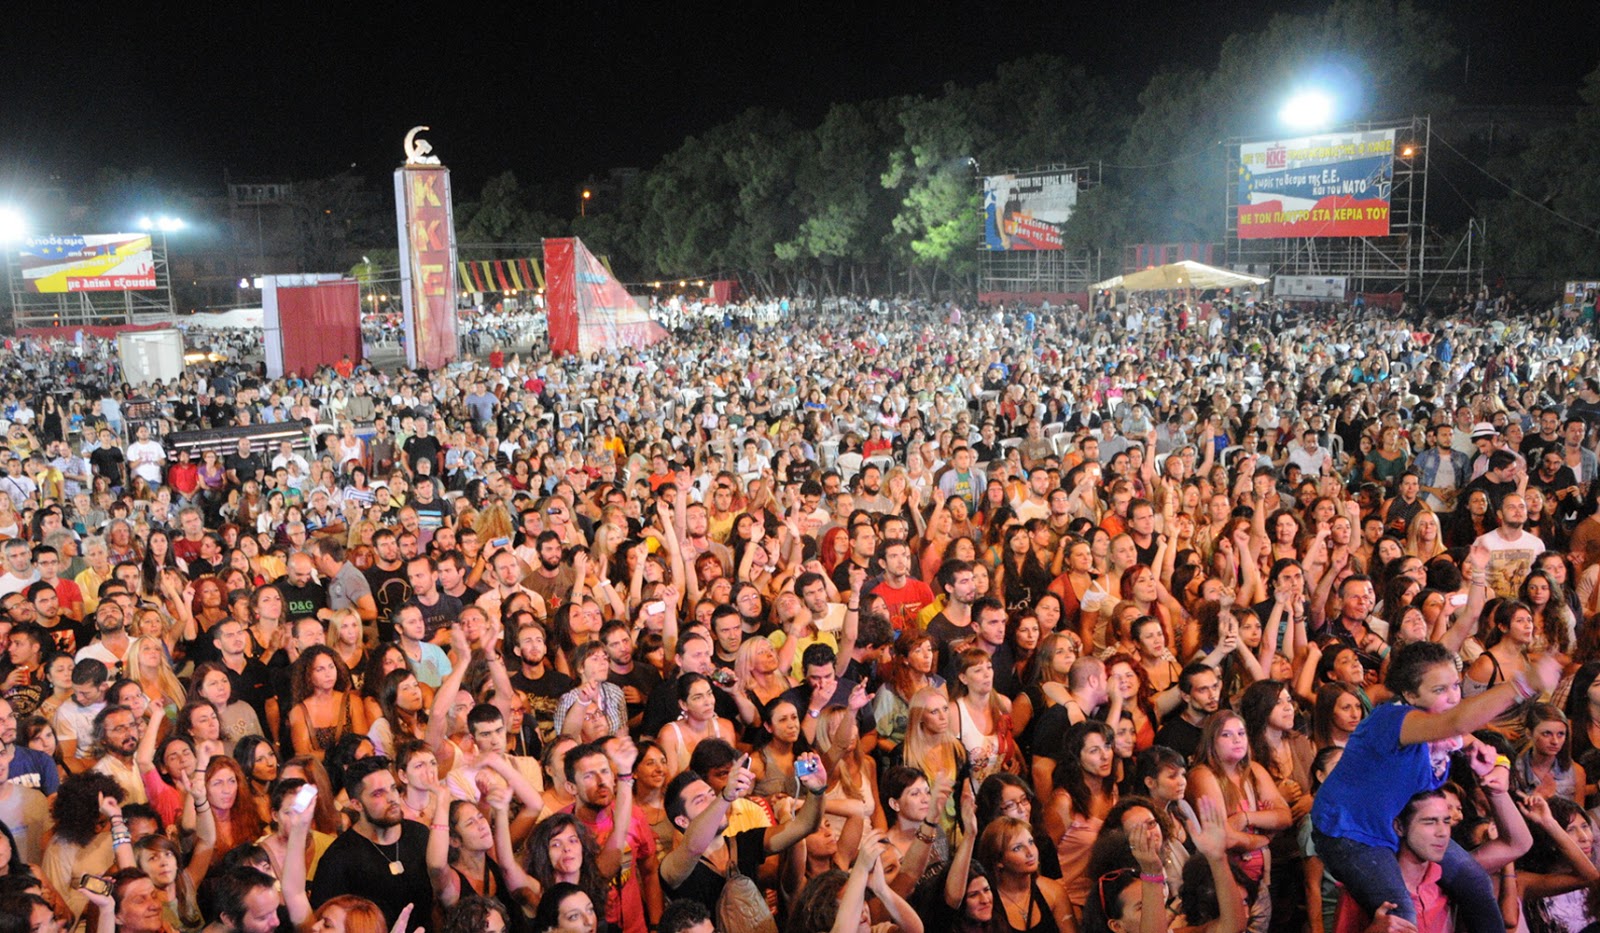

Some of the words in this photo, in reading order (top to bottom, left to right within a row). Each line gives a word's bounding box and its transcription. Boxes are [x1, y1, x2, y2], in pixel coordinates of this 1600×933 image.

[1266, 149, 1286, 166] ΚΚΕ
[1254, 212, 1272, 224] ΤΟΝ
[1312, 208, 1331, 221] ΣΤΑ
[1333, 207, 1363, 221] ΧΕΡΙΑ
[1366, 206, 1388, 220] ΤΟΥ
[68, 280, 80, 291] με
[289, 600, 314, 611] D&G
